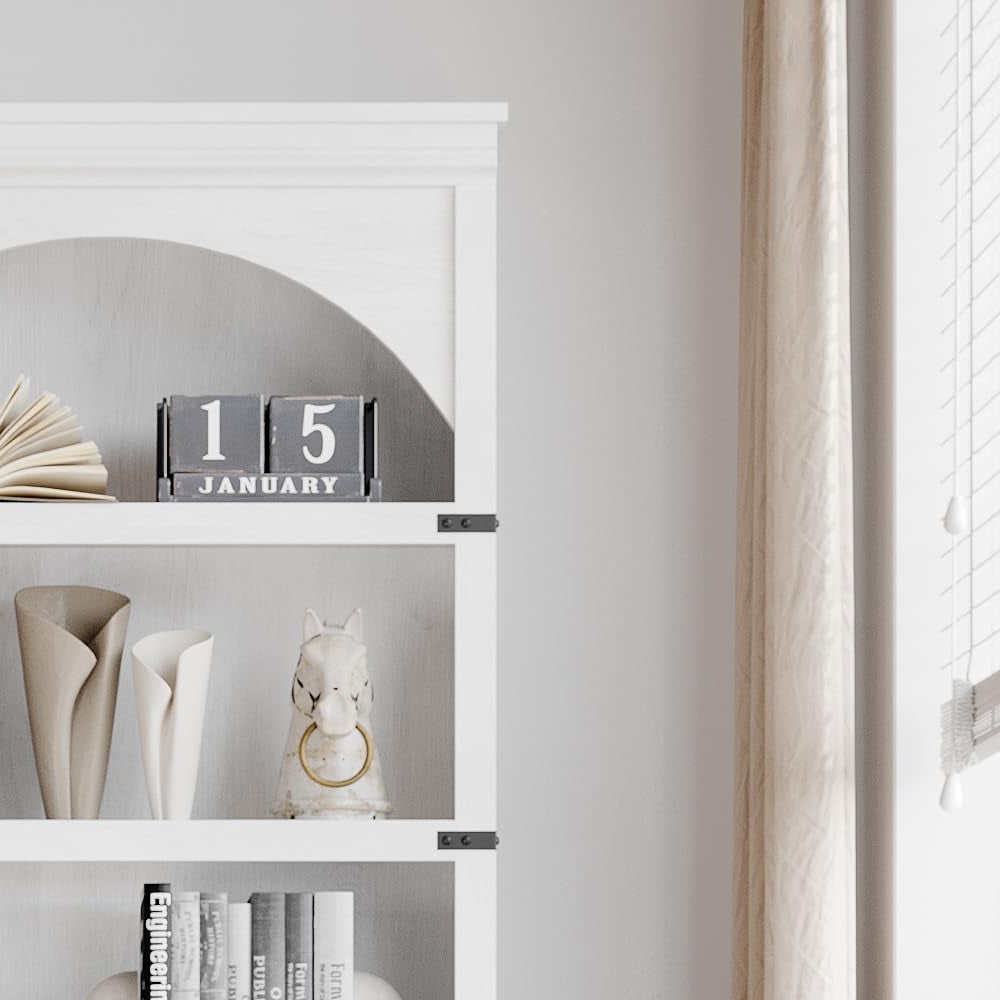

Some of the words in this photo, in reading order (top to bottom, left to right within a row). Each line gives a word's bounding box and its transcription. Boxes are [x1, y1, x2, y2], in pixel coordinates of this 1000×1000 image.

[200, 399, 226, 461] 1
[302, 403, 336, 465] 5
[198, 476, 338, 495] JANUARY
